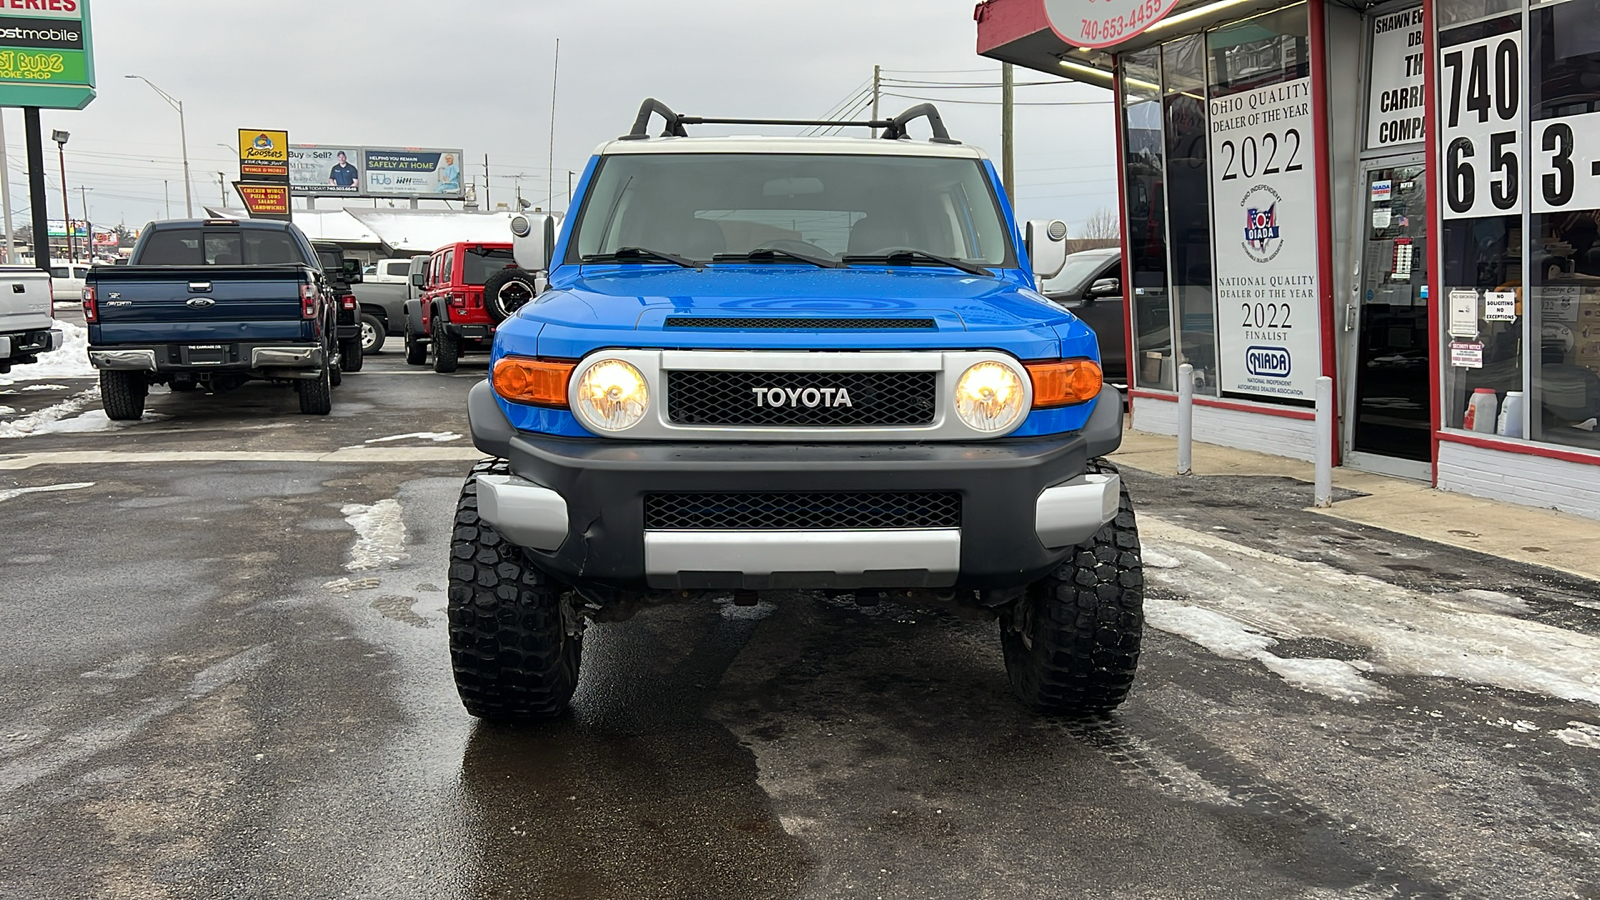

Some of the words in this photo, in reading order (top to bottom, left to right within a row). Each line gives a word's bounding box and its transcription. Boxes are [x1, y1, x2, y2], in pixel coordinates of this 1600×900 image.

[1080, 0, 1162, 40] 740-653-4455
[1376, 12, 1410, 34] SHAWN
[17, 52, 64, 73] BUDZ
[24, 71, 51, 80] SHOP
[1444, 38, 1519, 129] 740
[1211, 97, 1243, 116] OHIO
[1249, 81, 1310, 109] QUALITY
[1213, 115, 1247, 133] DEALER
[1248, 112, 1260, 126] OF
[1262, 108, 1281, 123] THE
[1282, 102, 1309, 119] YEAR
[313, 151, 333, 159] Sell?
[1221, 128, 1303, 181] 2022
[1250, 184, 1282, 203] INDEPENDENT
[1248, 228, 1274, 239] OIADA
[1219, 276, 1267, 286] NATIONAL
[1269, 275, 1315, 287] QUALITY
[1220, 289, 1252, 298] DEALER
[1254, 289, 1266, 298] OF
[1269, 289, 1286, 298] THE
[1290, 289, 1314, 298] YEAR
[1242, 302, 1292, 328] 2022
[1245, 331, 1288, 341] FINALIST
[1250, 352, 1287, 371] NIADA
[1266, 379, 1292, 387] INDEPENDENT
[751, 388, 853, 407] TOYOTA
